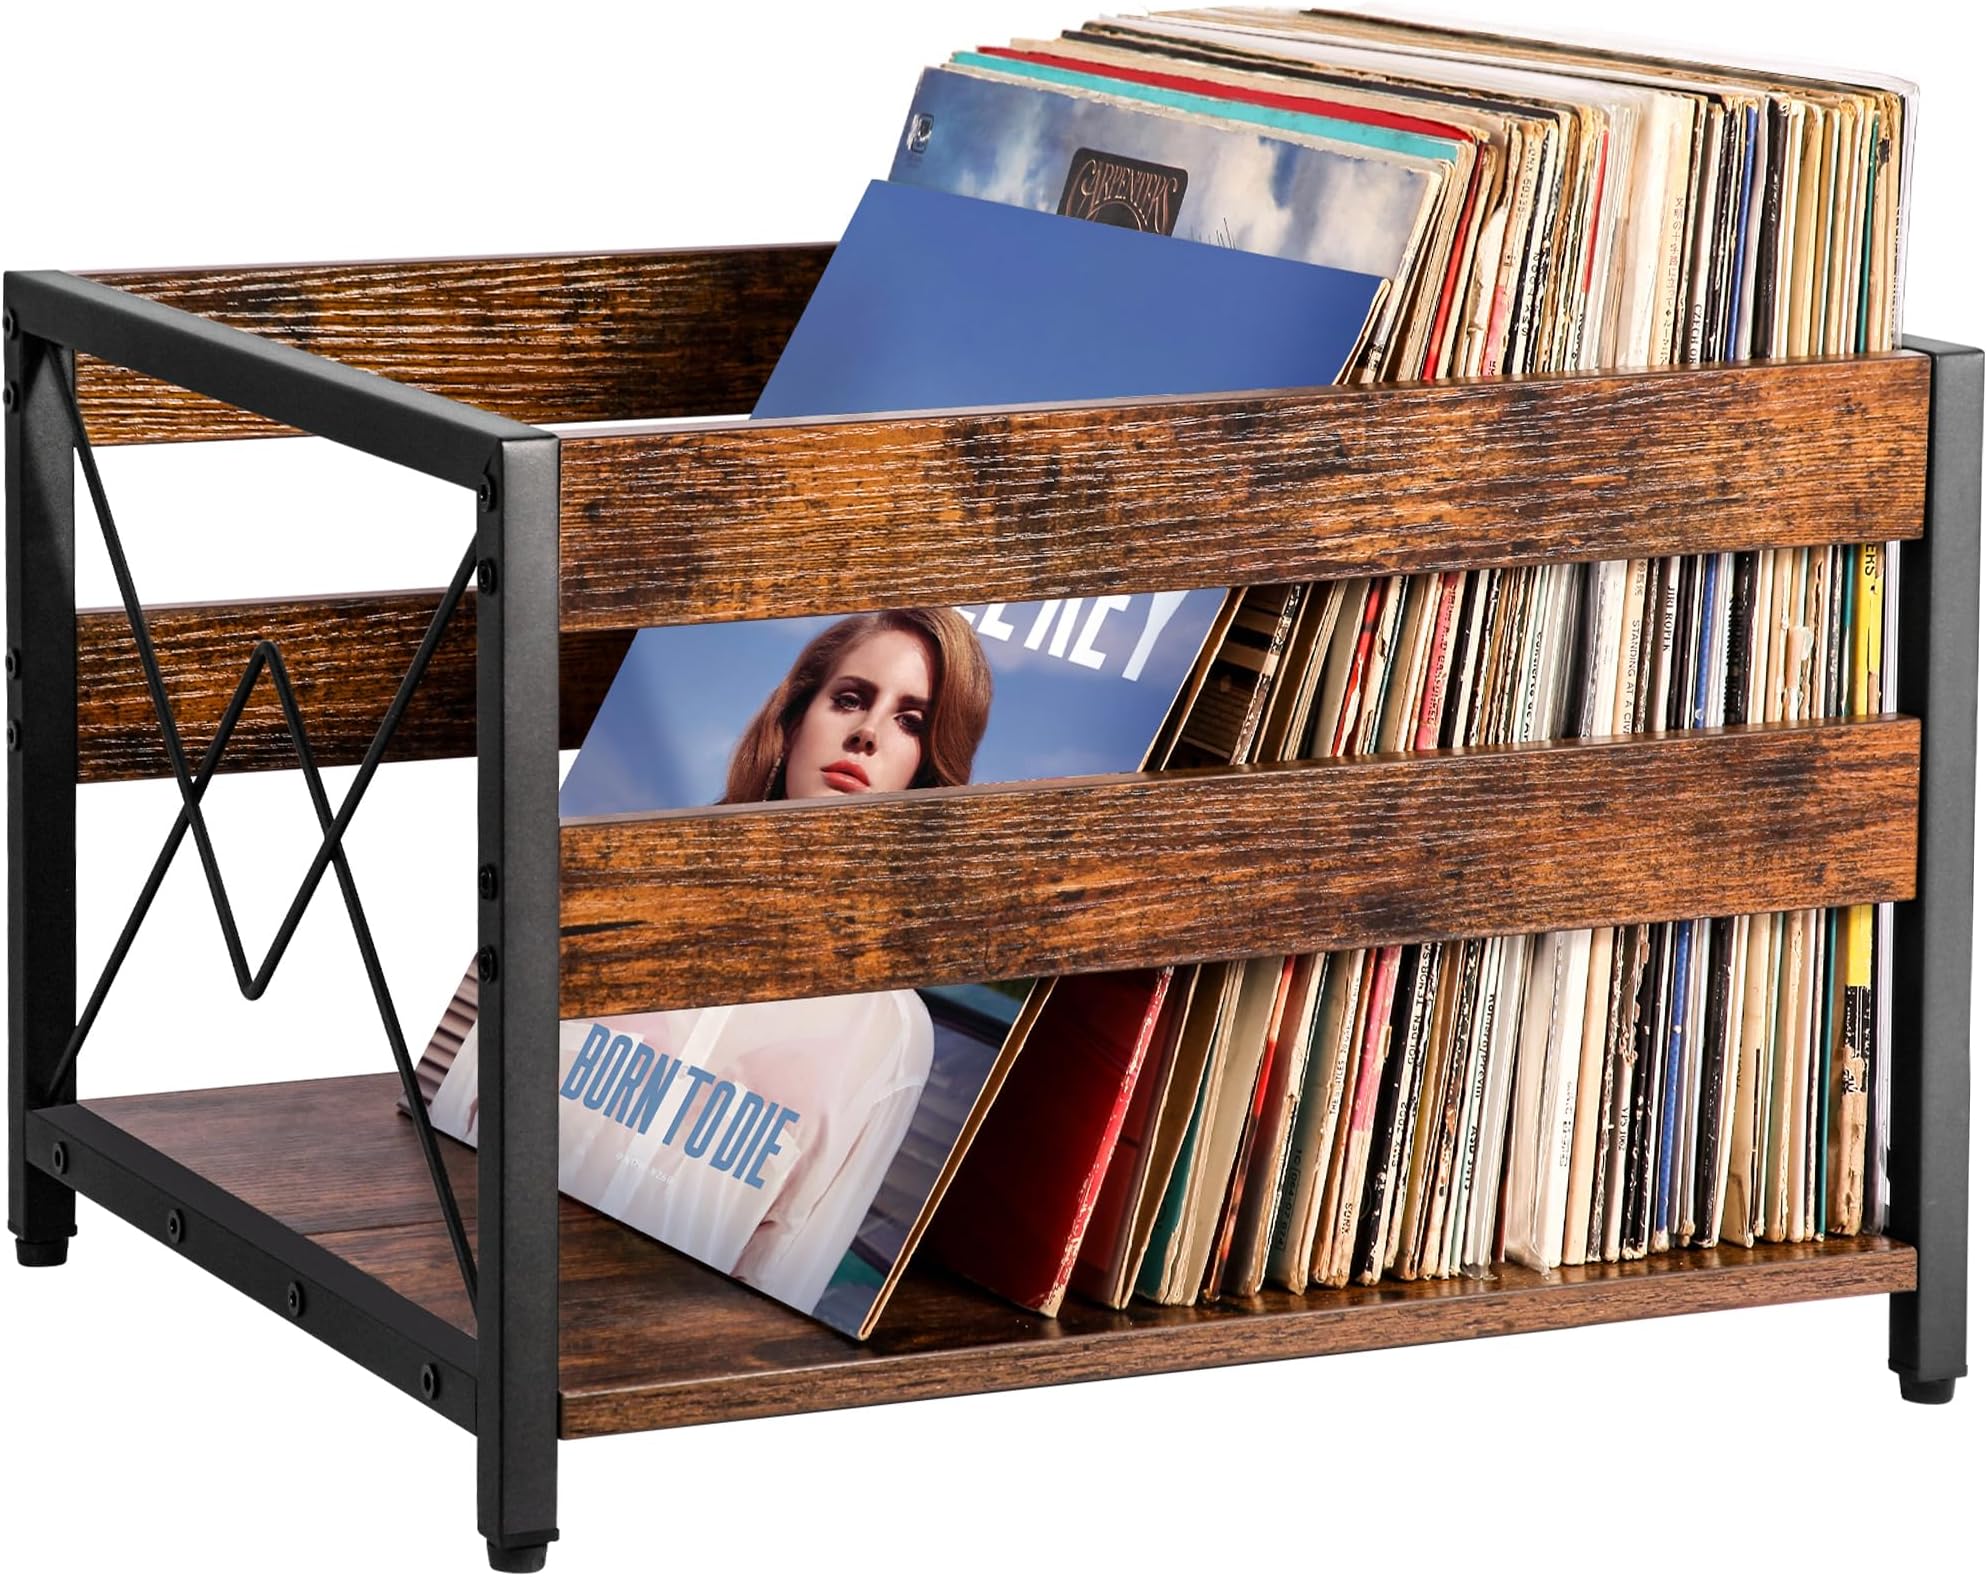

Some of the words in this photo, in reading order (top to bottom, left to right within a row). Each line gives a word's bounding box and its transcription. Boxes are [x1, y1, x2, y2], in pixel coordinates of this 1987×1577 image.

[1067, 158, 1178, 234] CARPENTERS
[1690, 304, 1703, 345] CZECH
[1664, 585, 1676, 609] JIRI
[1627, 619, 1641, 678] STANDING
[1625, 681, 1635, 697] AT
[1625, 700, 1633, 709] A
[560, 1023, 683, 1136] BORN
[663, 1065, 737, 1159] TO
[708, 1088, 801, 1190] DIE
